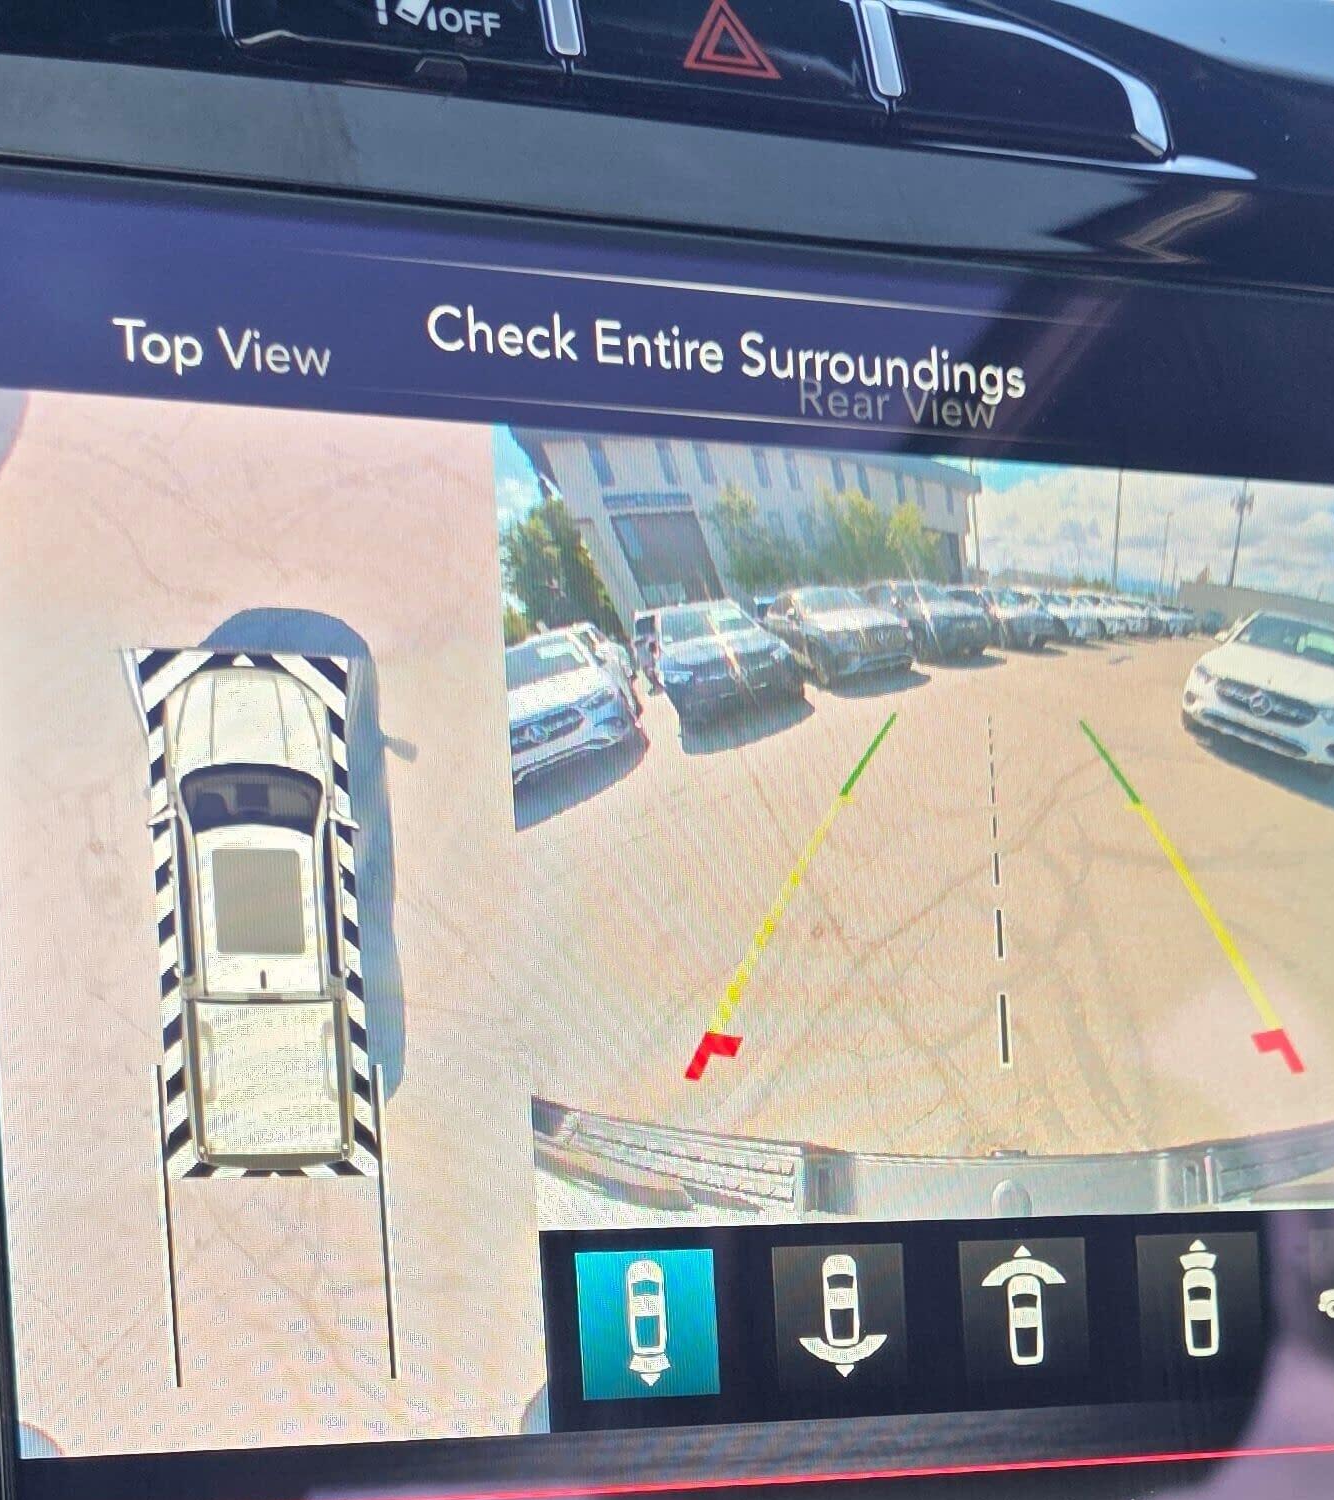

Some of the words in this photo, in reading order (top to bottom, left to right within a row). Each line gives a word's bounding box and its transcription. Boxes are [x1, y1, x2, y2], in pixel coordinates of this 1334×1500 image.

[438, 6, 501, 38] OFF
[112, 316, 203, 374] Top
[214, 323, 331, 378] View
[426, 304, 578, 364] Check
[593, 318, 725, 376] Entire
[740, 332, 1027, 405] Surroundings
[798, 376, 891, 423] Rear
[901, 385, 998, 430] View
